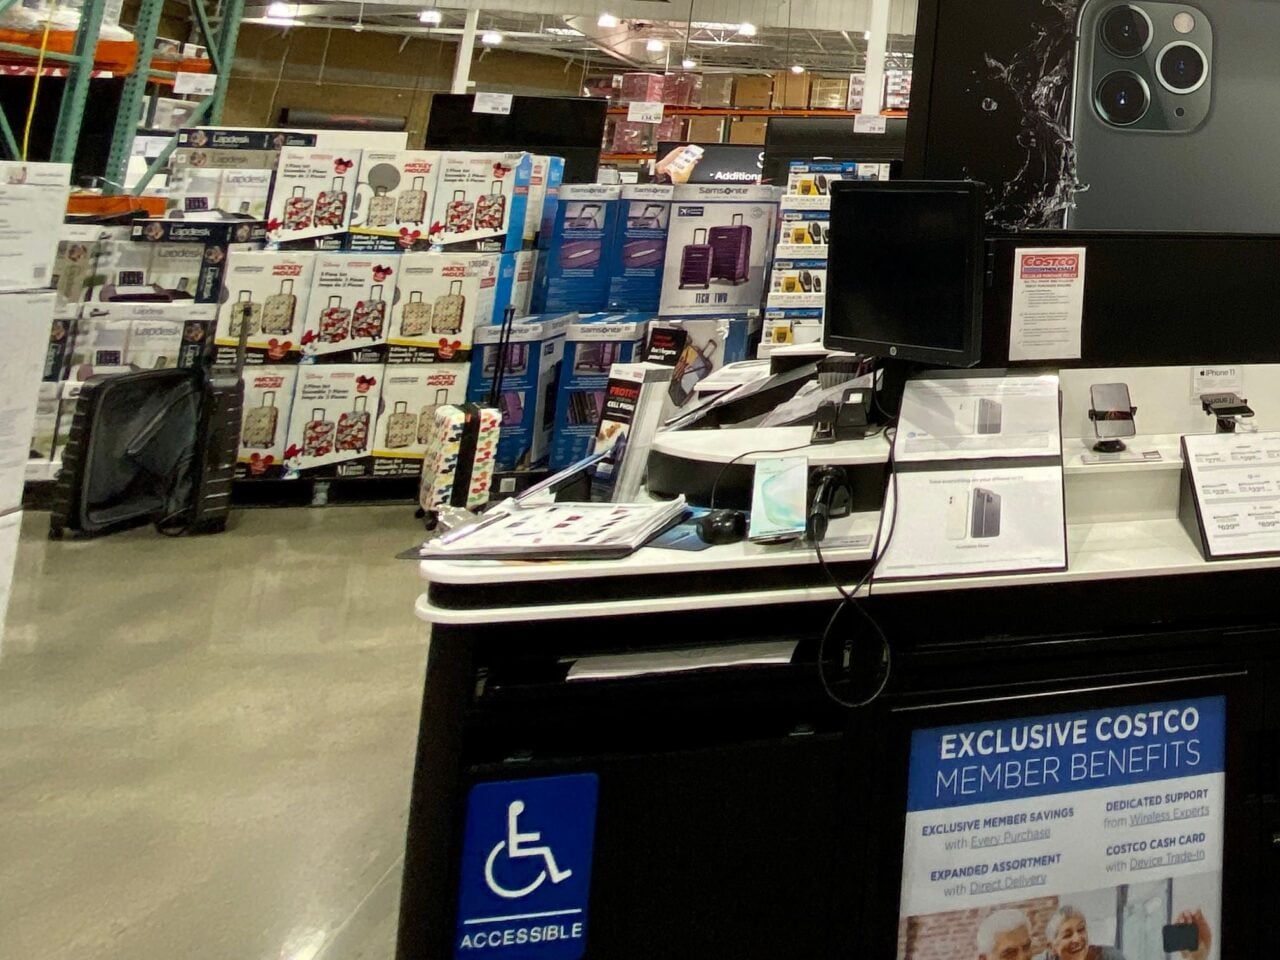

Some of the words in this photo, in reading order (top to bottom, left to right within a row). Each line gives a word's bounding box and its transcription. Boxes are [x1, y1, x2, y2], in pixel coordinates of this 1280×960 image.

[570, 186, 607, 194] Samsonite
[633, 186, 670, 194] Samsonite
[699, 186, 748, 195] Samsonite
[1023, 256, 1076, 266] COSTCO
[580, 326, 622, 334] Samsonite
[940, 720, 1087, 760] EXCLUSIVE
[1095, 707, 1199, 741] COSTCO
[936, 757, 1061, 797] MEMBER
[1070, 739, 1200, 781] BENEFITS
[1106, 796, 1162, 812] DEDICATED
[1165, 789, 1209, 804] SUPPORT
[922, 819, 981, 837] EXCLUSIVE
[983, 812, 1027, 829] MEMBER
[1029, 807, 1075, 823] SAVINGS
[1103, 816, 1128, 829] from
[1129, 810, 1171, 827] Wireless
[1173, 804, 1210, 823] Experts
[944, 837, 968, 850] with
[970, 832, 1001, 850] Every
[1004, 827, 1051, 844] Purchase
[1106, 841, 1147, 856] COSTCO
[1149, 837, 1176, 850] CASH
[1178, 832, 1206, 846] CARD
[930, 864, 989, 882] EXPANDED
[991, 854, 1061, 873] ASSORTMENT
[1106, 860, 1128, 873] with
[1130, 856, 1163, 870] Device
[944, 884, 967, 897] with
[970, 879, 1001, 896] Direct
[1004, 874, 1047, 890] Delivery
[460, 923, 582, 949] ACCESSIBLE
